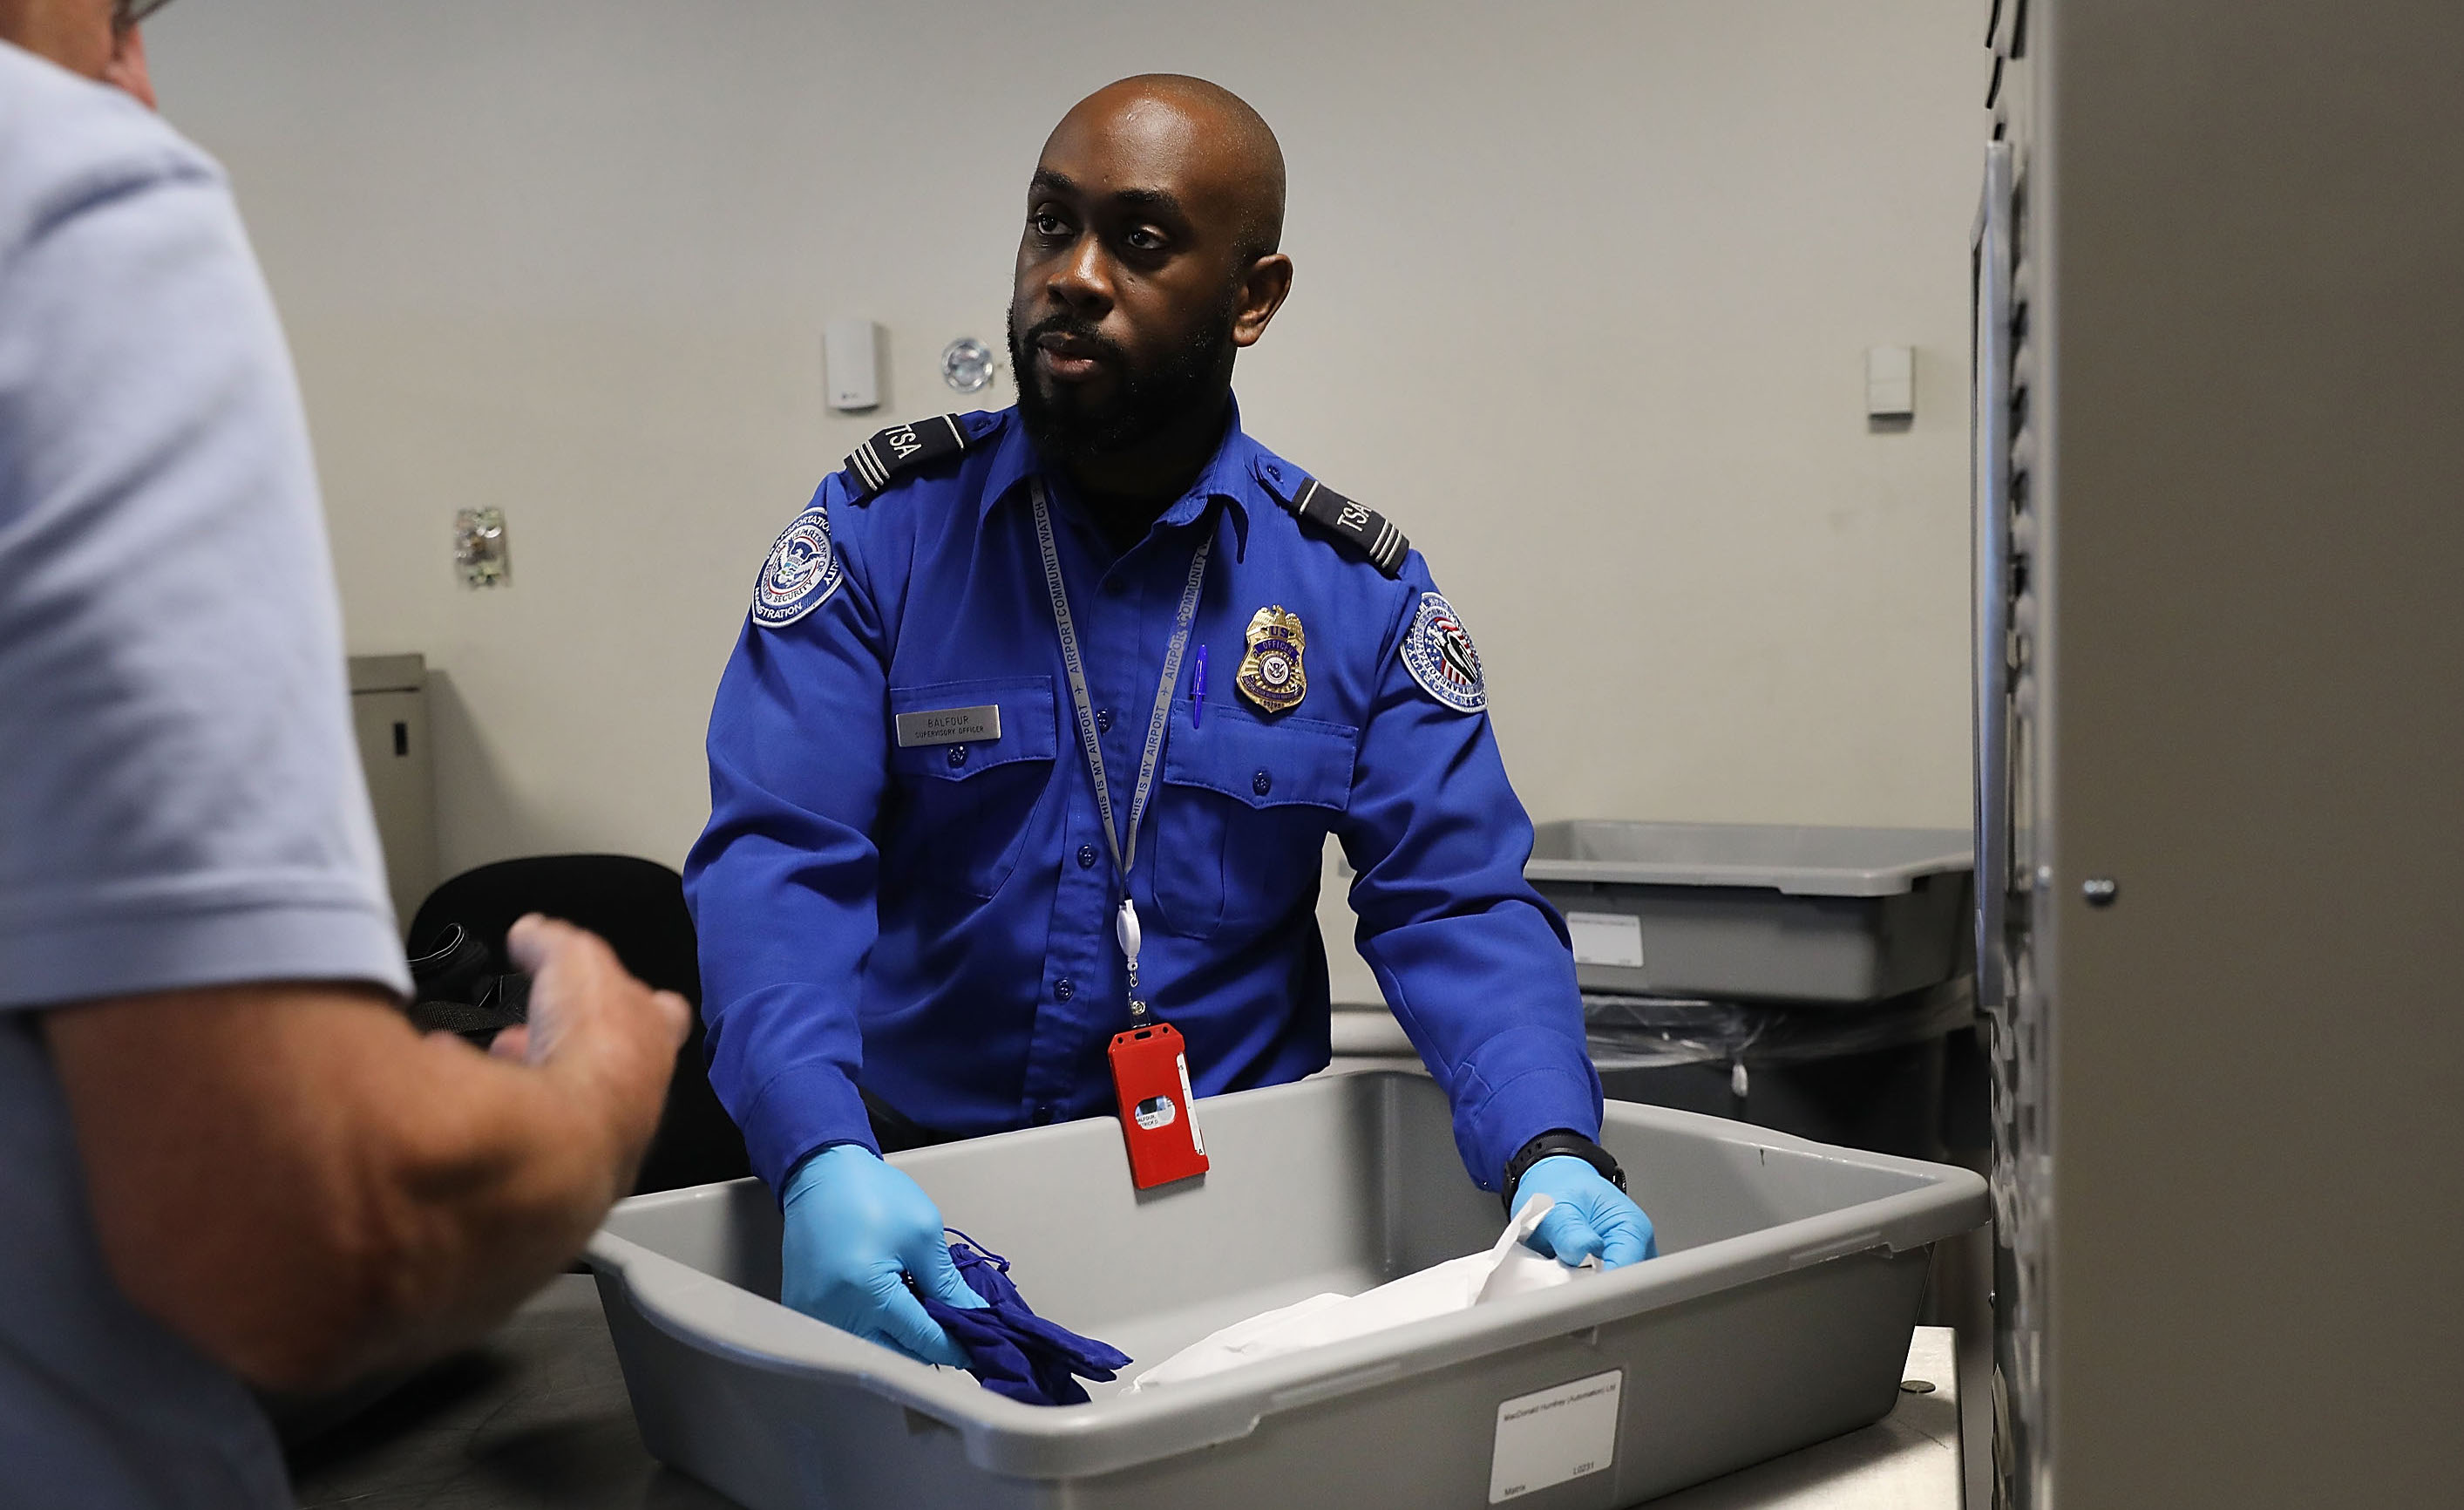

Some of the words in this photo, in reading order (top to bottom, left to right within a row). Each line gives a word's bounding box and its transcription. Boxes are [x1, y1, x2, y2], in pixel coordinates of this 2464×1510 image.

[886, 425, 921, 459] TSA
[1035, 502, 1052, 544] WATCH
[1336, 500, 1372, 532] TSA
[773, 580, 812, 602] SECURITY
[1042, 545, 1069, 617] COMMUNITY
[1057, 620, 1079, 674] AIRPORT
[1164, 629, 1186, 680] AIRPOR
[1262, 640, 1293, 654] OFFICER
[1407, 649, 1475, 706] INTEGRITY
[915, 729, 955, 738] SUPERVISORY
[958, 725, 984, 734] OFFICER
[927, 716, 969, 728] BALFOUR
[1078, 704, 1101, 754] AIRPORT
[1146, 705, 1166, 756] AIRPORT
[1091, 760, 1103, 776] MY
[1142, 761, 1153, 778] MY
[1096, 780, 1104, 791] IS
[1139, 782, 1148, 792] IS
[1099, 796, 1110, 821] THIS
[1131, 797, 1143, 821] THIS
